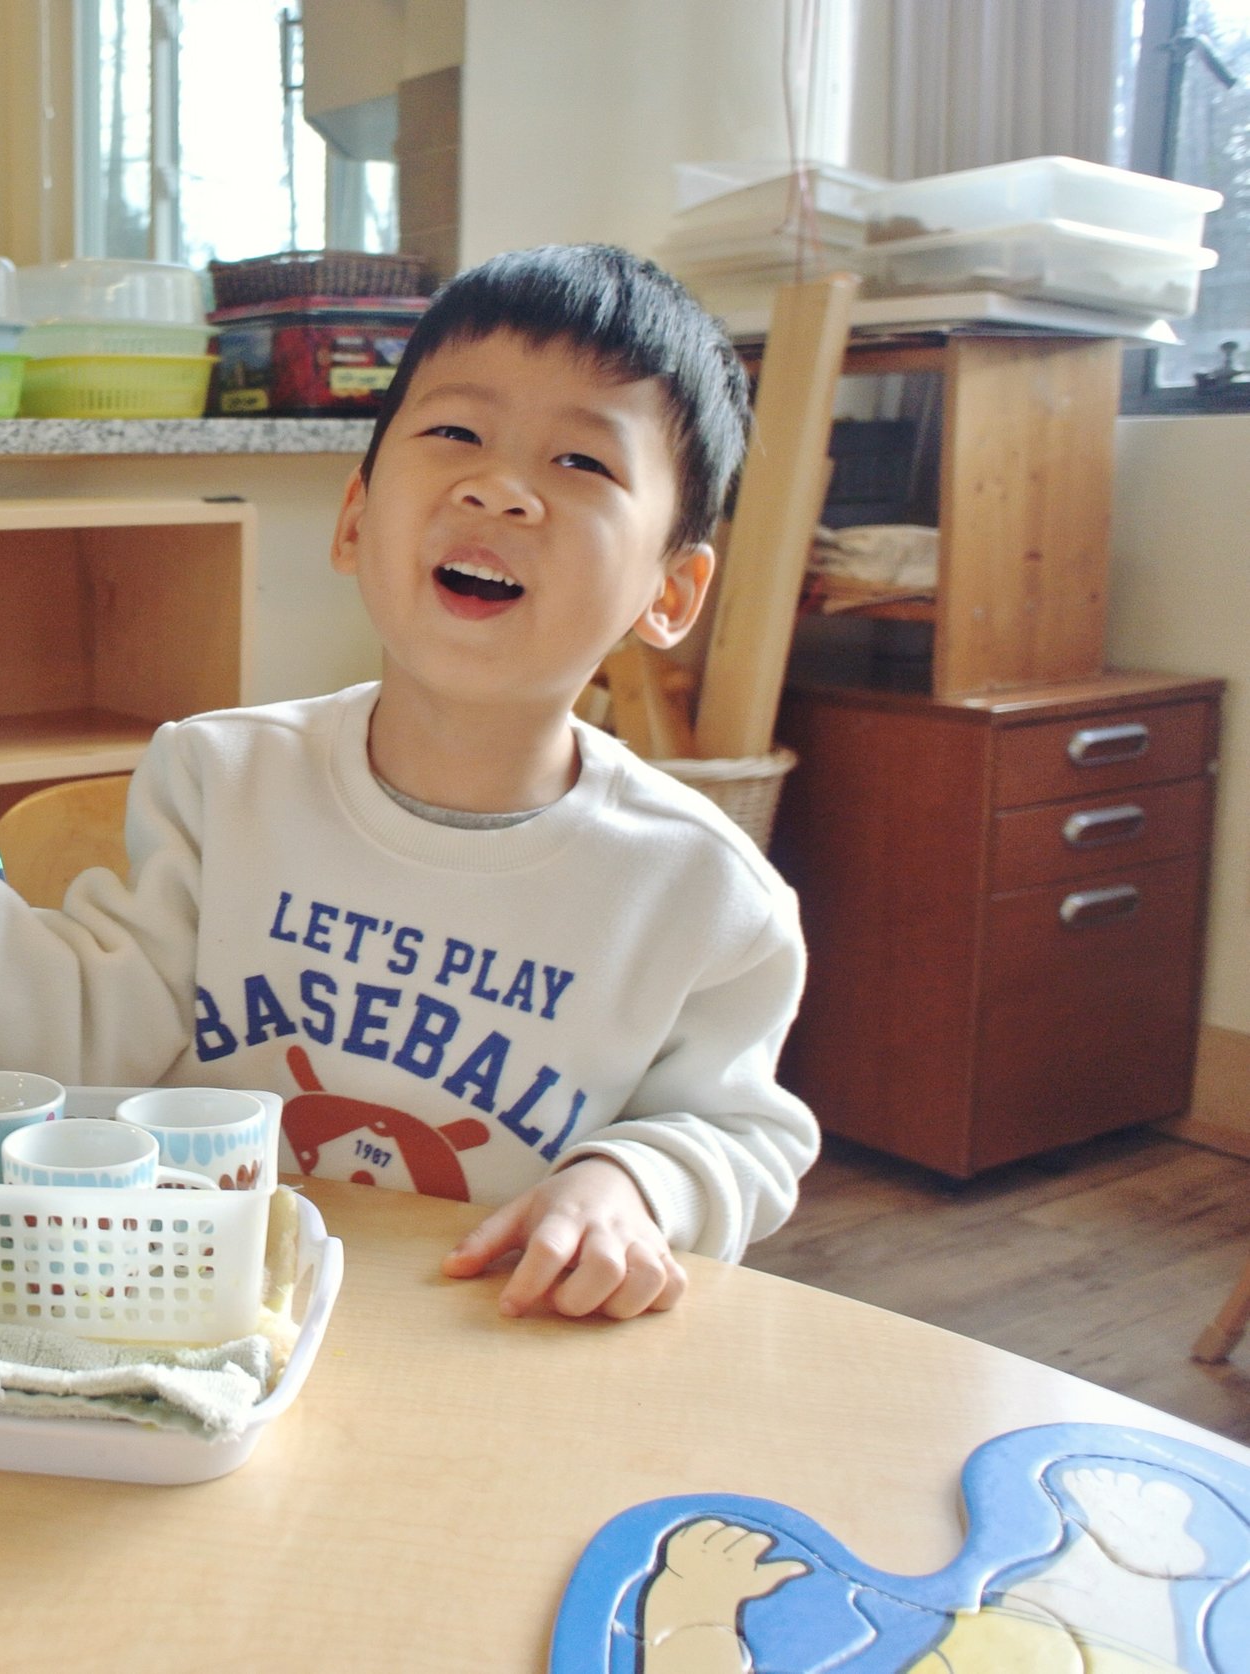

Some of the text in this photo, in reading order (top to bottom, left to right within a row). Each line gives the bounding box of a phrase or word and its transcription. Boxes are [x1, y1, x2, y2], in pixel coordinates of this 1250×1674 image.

[268, 890, 575, 1021] LET'S PLAY
[354, 1139, 392, 1168] 1987
